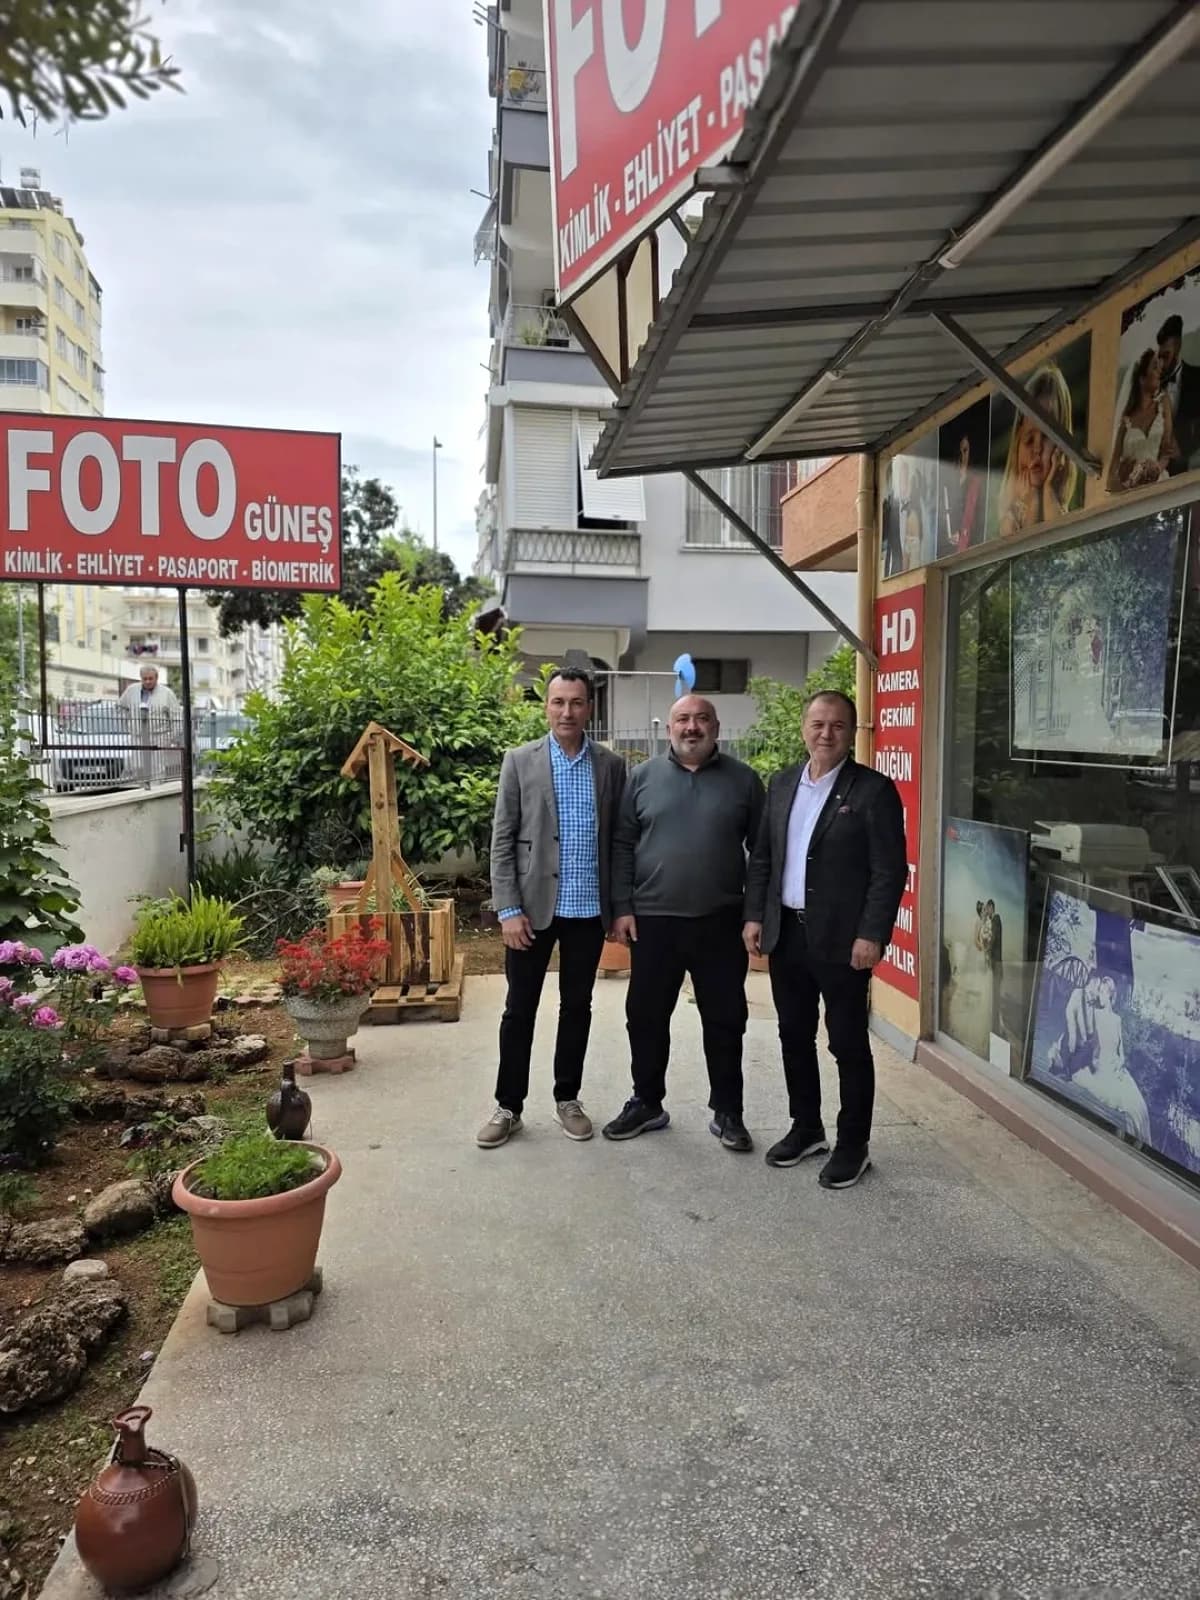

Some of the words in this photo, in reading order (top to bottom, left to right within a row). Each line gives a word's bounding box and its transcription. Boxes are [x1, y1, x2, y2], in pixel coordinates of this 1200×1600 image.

[560, 183, 611, 273] KİMLİK
[623, 94, 702, 216] EHLİYET
[7, 429, 237, 541] FOTO
[244, 495, 333, 553] GÜNEŞ
[5, 546, 63, 574] KİMLİK
[77, 549, 144, 576] EHLİYET
[158, 556, 239, 580] PASAPORT
[252, 555, 335, 584] BİOMETRİK
[881, 608, 917, 656] HD
[877, 669, 920, 693] KAMERA
[880, 702, 915, 732] ÇEKİMİ
[875, 745, 912, 782] DÜĞÜN
